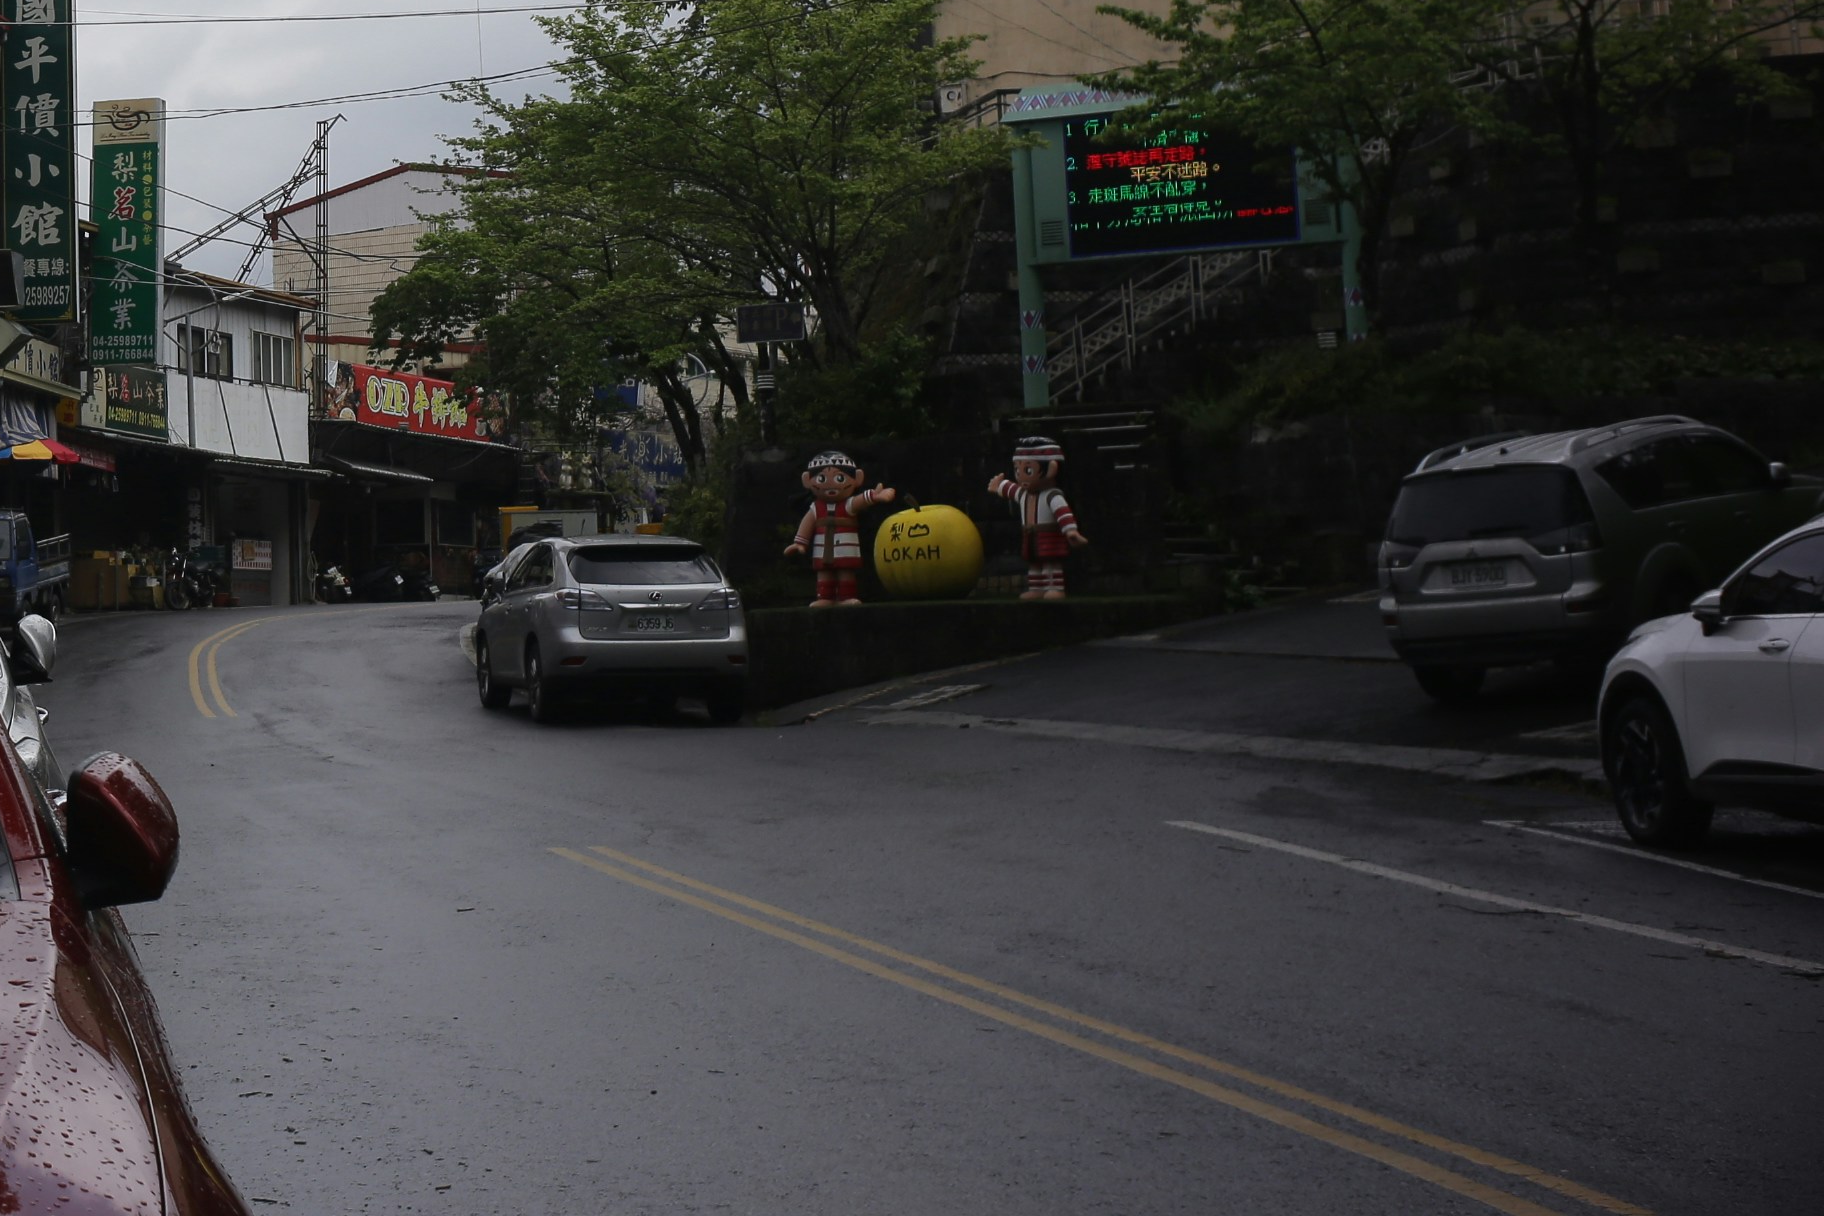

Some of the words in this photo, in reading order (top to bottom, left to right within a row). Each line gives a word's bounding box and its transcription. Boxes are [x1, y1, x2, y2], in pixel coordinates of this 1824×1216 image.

[108, 150, 138, 331] 梨茗山茶業
[25, 285, 70, 306] 25989257
[92, 334, 153, 347] 04-25989711
[92, 348, 153, 361] 0911-766844
[883, 544, 941, 563] LOKAH
